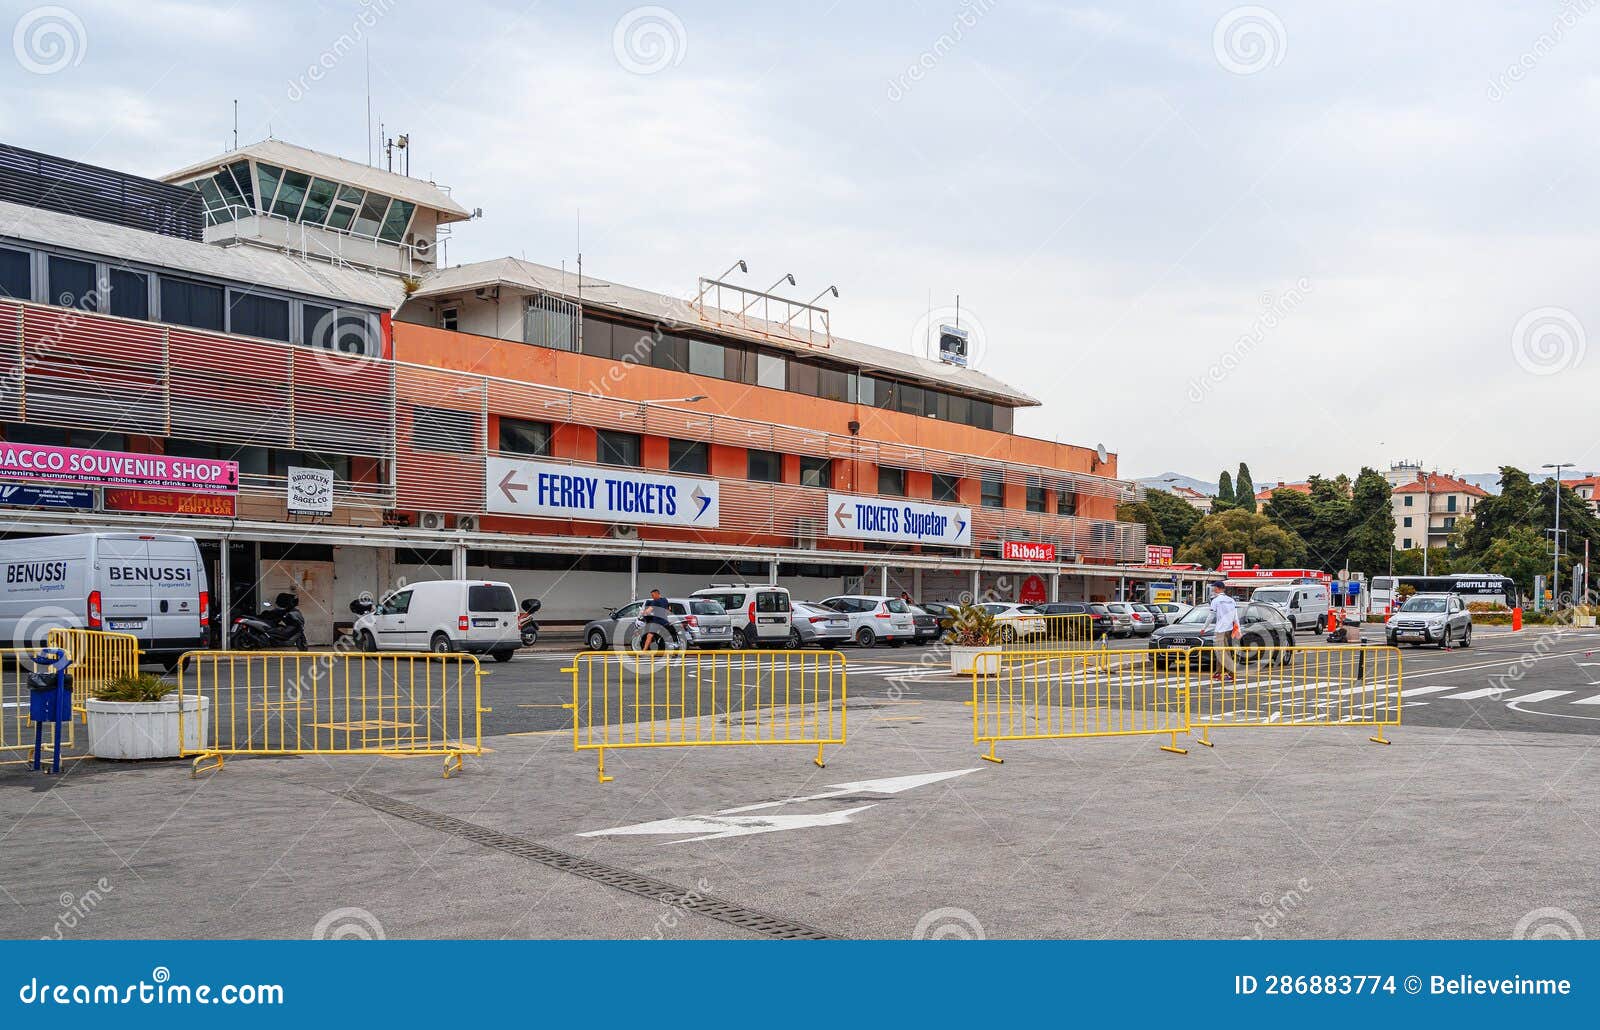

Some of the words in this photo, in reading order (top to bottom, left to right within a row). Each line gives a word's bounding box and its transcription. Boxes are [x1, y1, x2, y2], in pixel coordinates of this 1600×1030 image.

[0, 449, 64, 470] ACCO
[69, 454, 167, 477] SOUVENIR
[172, 462, 221, 481] SHOP
[42, 471, 76, 479] summer
[78, 473, 101, 481] items
[107, 475, 136, 483] nibbles
[292, 474, 329, 484] BROOKLYN
[138, 492, 174, 506] Last
[180, 495, 231, 508] minute
[292, 494, 317, 504] BAGEL
[538, 473, 598, 509] FERRY
[605, 479, 676, 516] TICKETS
[178, 504, 203, 514] RENT
[205, 506, 211, 514] A
[213, 506, 231, 515] CAR
[856, 504, 899, 533] TICKETS
[904, 507, 947, 539] Supetar
[1011, 543, 1045, 559] Ribola
